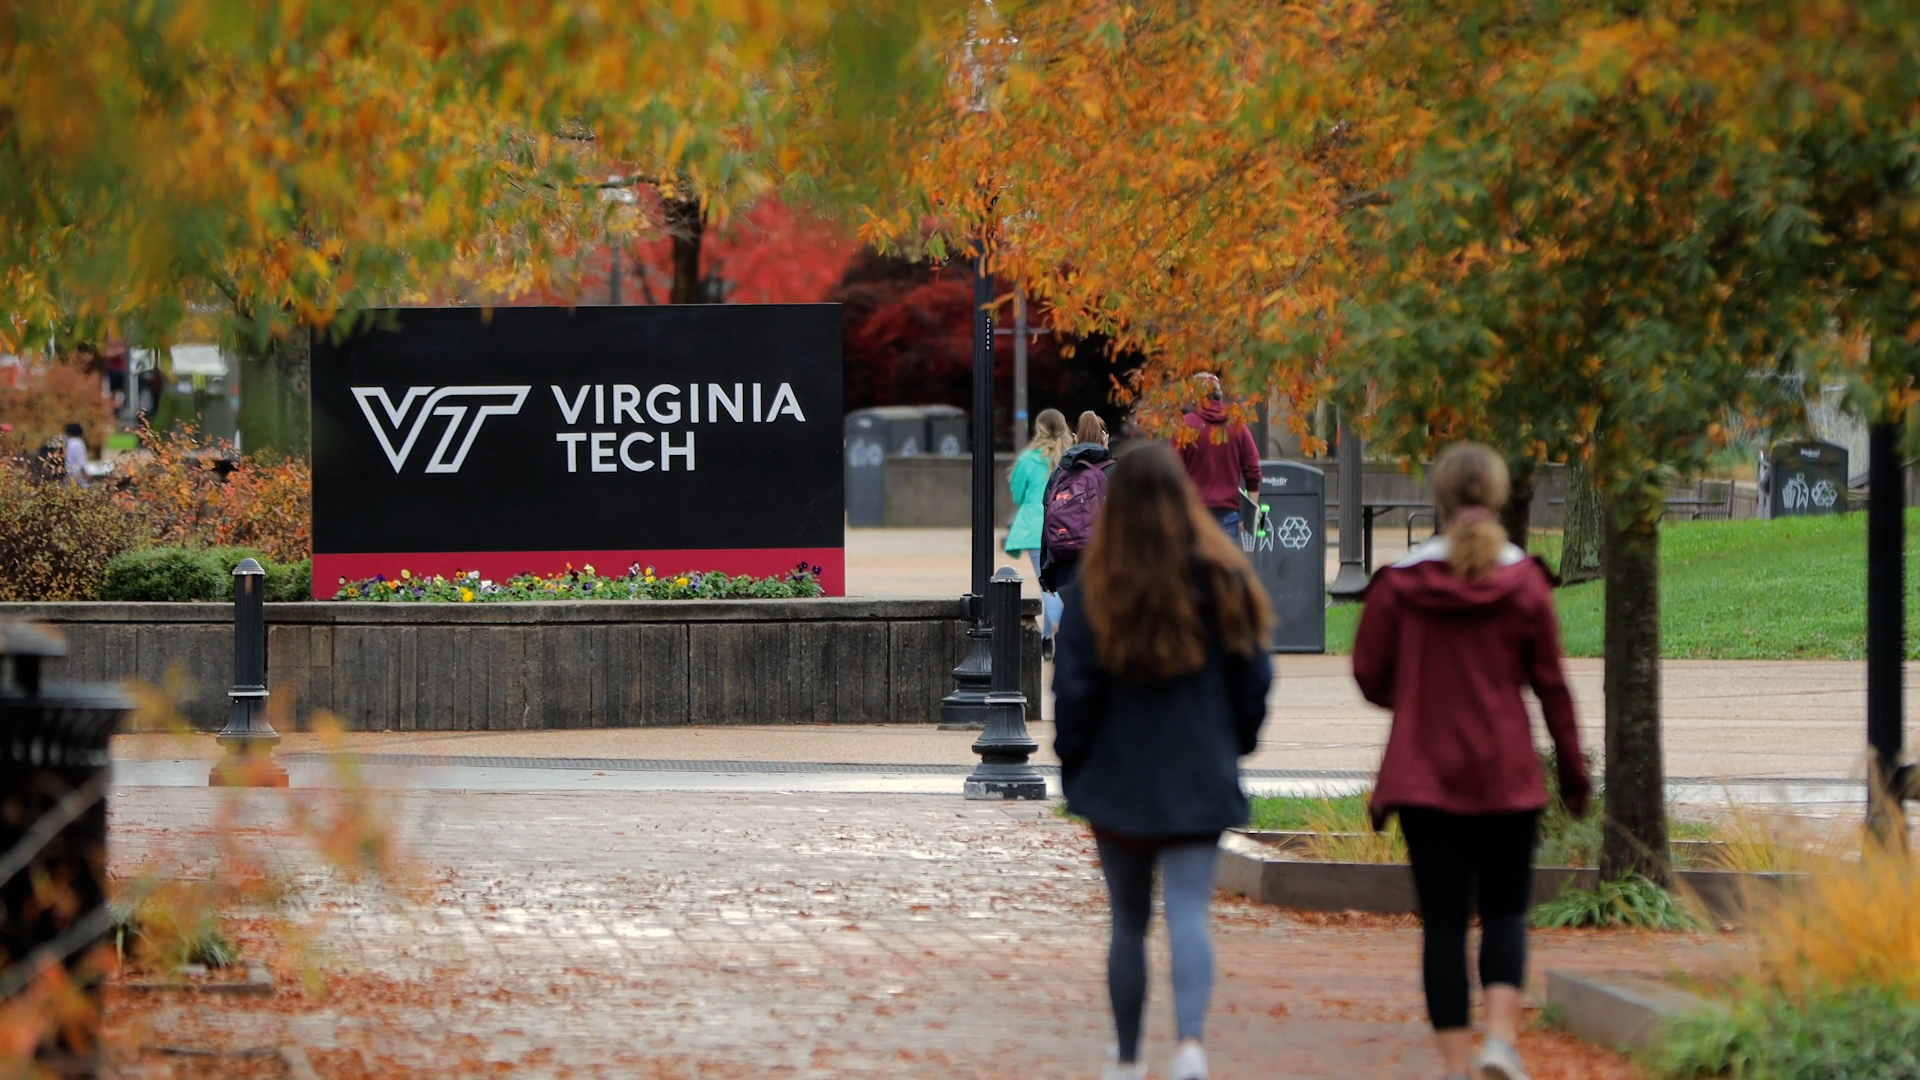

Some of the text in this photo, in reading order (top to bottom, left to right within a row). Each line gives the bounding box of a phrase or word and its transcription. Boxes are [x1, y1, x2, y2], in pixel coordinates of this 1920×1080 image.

[551, 382, 806, 425] VIRGINIA
[351, 386, 531, 473] VT
[556, 431, 695, 473] TECH
